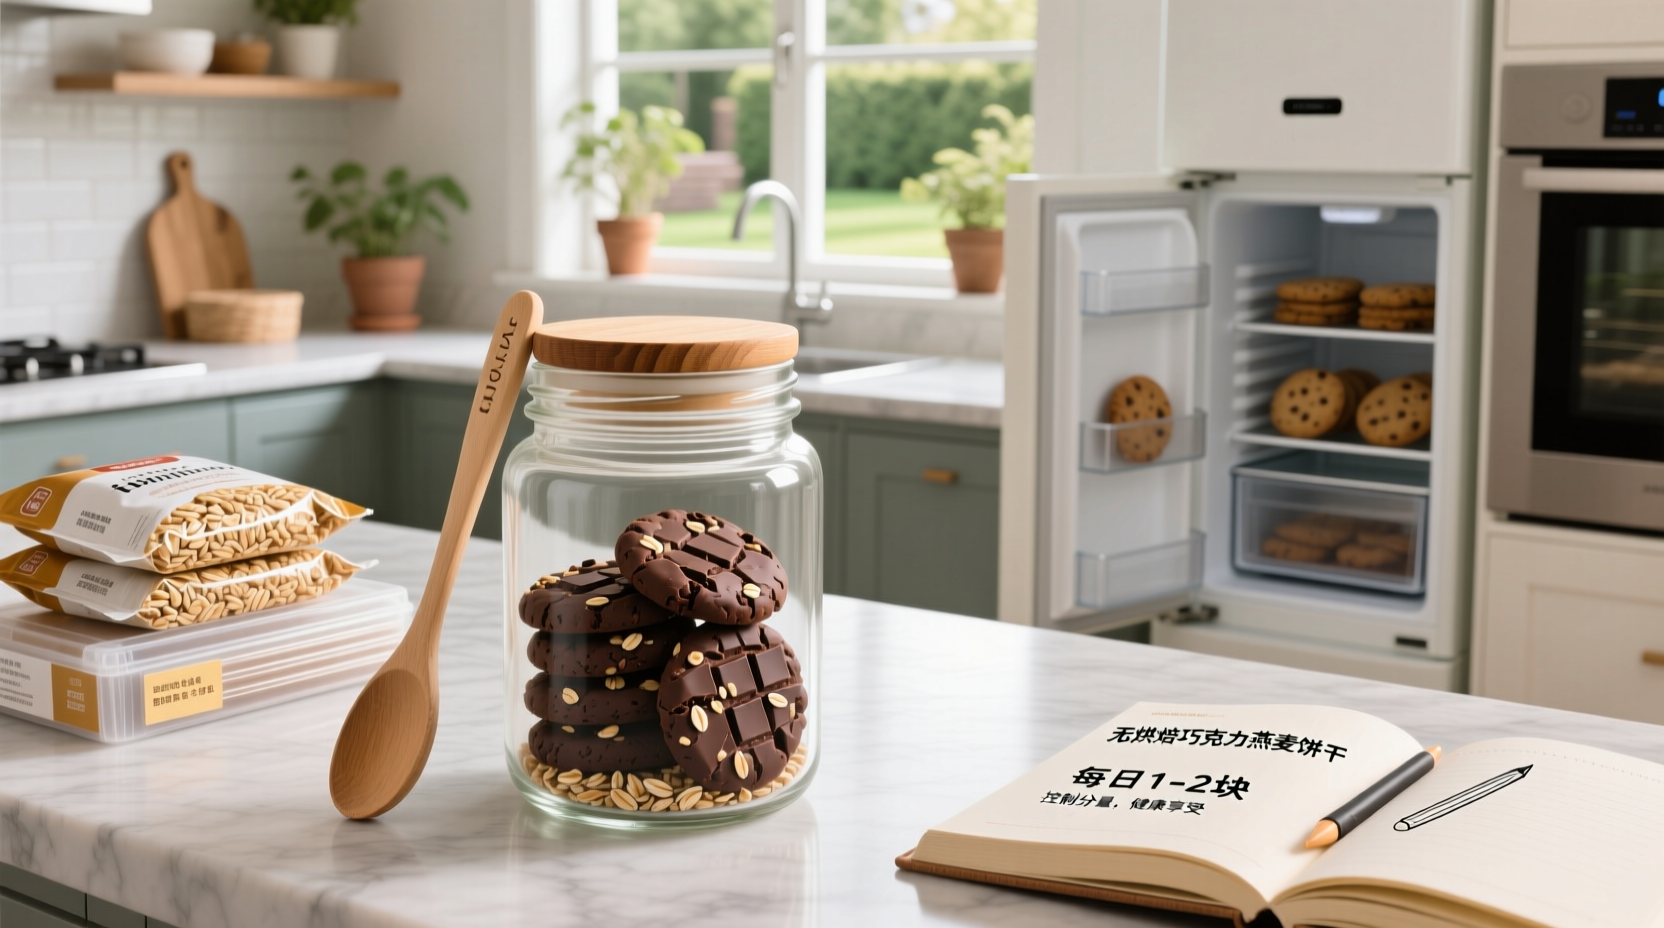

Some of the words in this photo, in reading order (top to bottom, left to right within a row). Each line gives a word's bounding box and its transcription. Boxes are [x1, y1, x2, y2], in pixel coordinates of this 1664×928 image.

[1106, 726, 1348, 763] 无烘焙巧克力燕麦饼干
[1072, 766, 1251, 801] 每日1-2块
